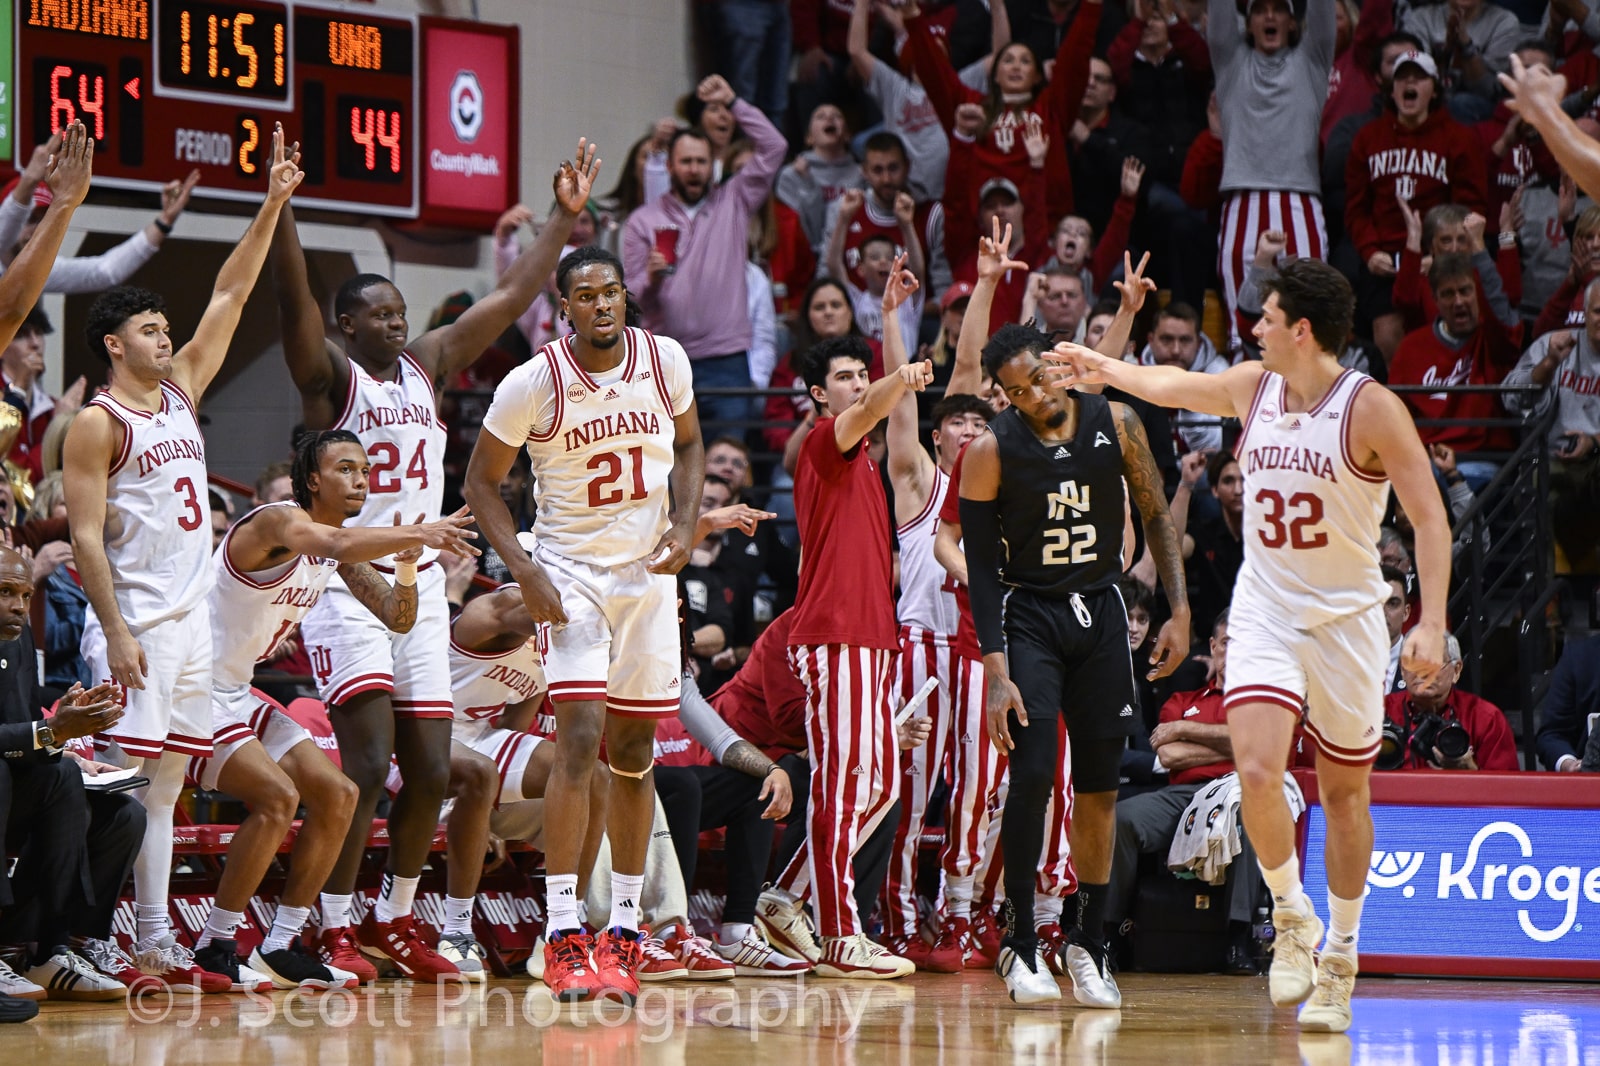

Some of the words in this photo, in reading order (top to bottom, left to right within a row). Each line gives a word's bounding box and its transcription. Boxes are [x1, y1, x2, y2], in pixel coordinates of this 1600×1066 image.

[180, 10, 285, 89] 11:51
[51, 65, 104, 140] 64
[174, 127, 232, 166] PERIOD
[239, 118, 259, 174] 2
[351, 106, 401, 173] 44
[430, 148, 500, 178] CountryMark
[1368, 147, 1449, 185] INDIANA
[358, 403, 433, 434] INDIANA
[563, 411, 660, 452] INDIANA
[136, 438, 205, 479] INDIANA
[367, 438, 429, 494] 24
[586, 445, 649, 508] 21
[1247, 446, 1338, 484] INDIANA
[173, 476, 203, 532] 3
[1255, 487, 1329, 550] 32
[1042, 524, 1098, 566] 22
